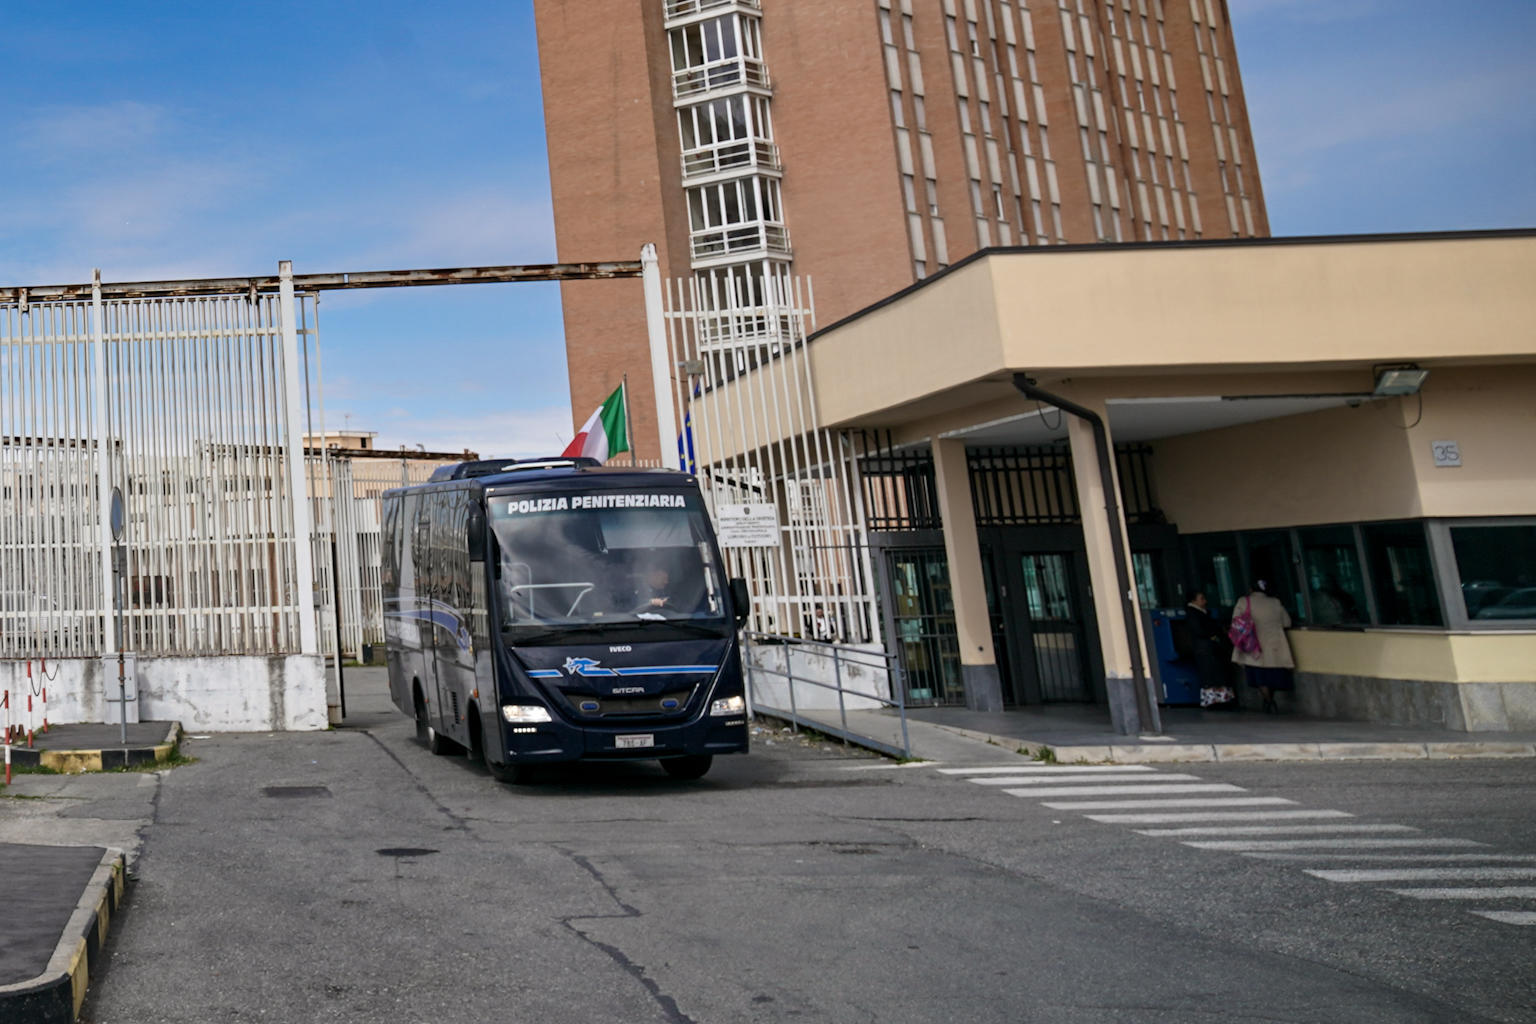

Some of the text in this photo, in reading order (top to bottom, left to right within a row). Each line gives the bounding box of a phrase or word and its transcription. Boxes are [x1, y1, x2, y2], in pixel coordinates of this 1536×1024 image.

[1435, 445, 1460, 461] 35
[508, 494, 686, 514] POLIZIA PENITENZIARIA
[609, 645, 632, 653] IVECO
